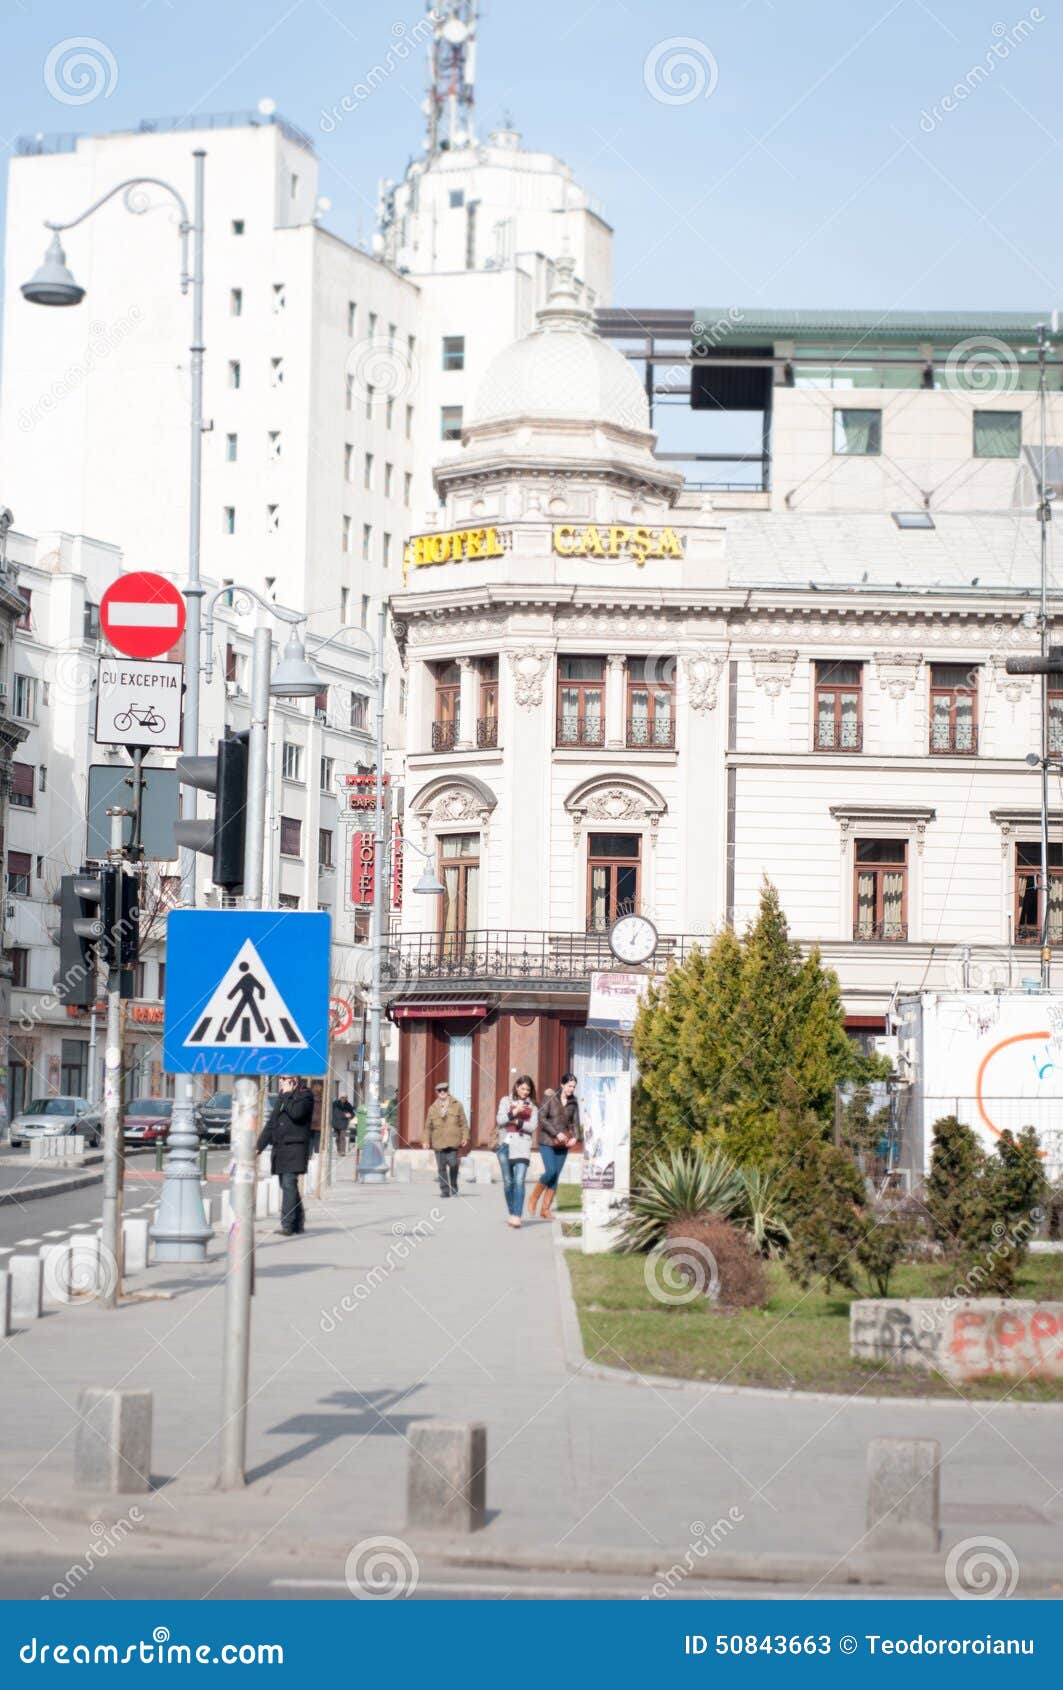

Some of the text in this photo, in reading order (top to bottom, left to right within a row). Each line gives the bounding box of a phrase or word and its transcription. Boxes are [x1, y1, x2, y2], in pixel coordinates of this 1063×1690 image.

[412, 527, 504, 568] HOTEL
[102, 671, 117, 685] CU
[359, 833, 376, 907] HOTEL
